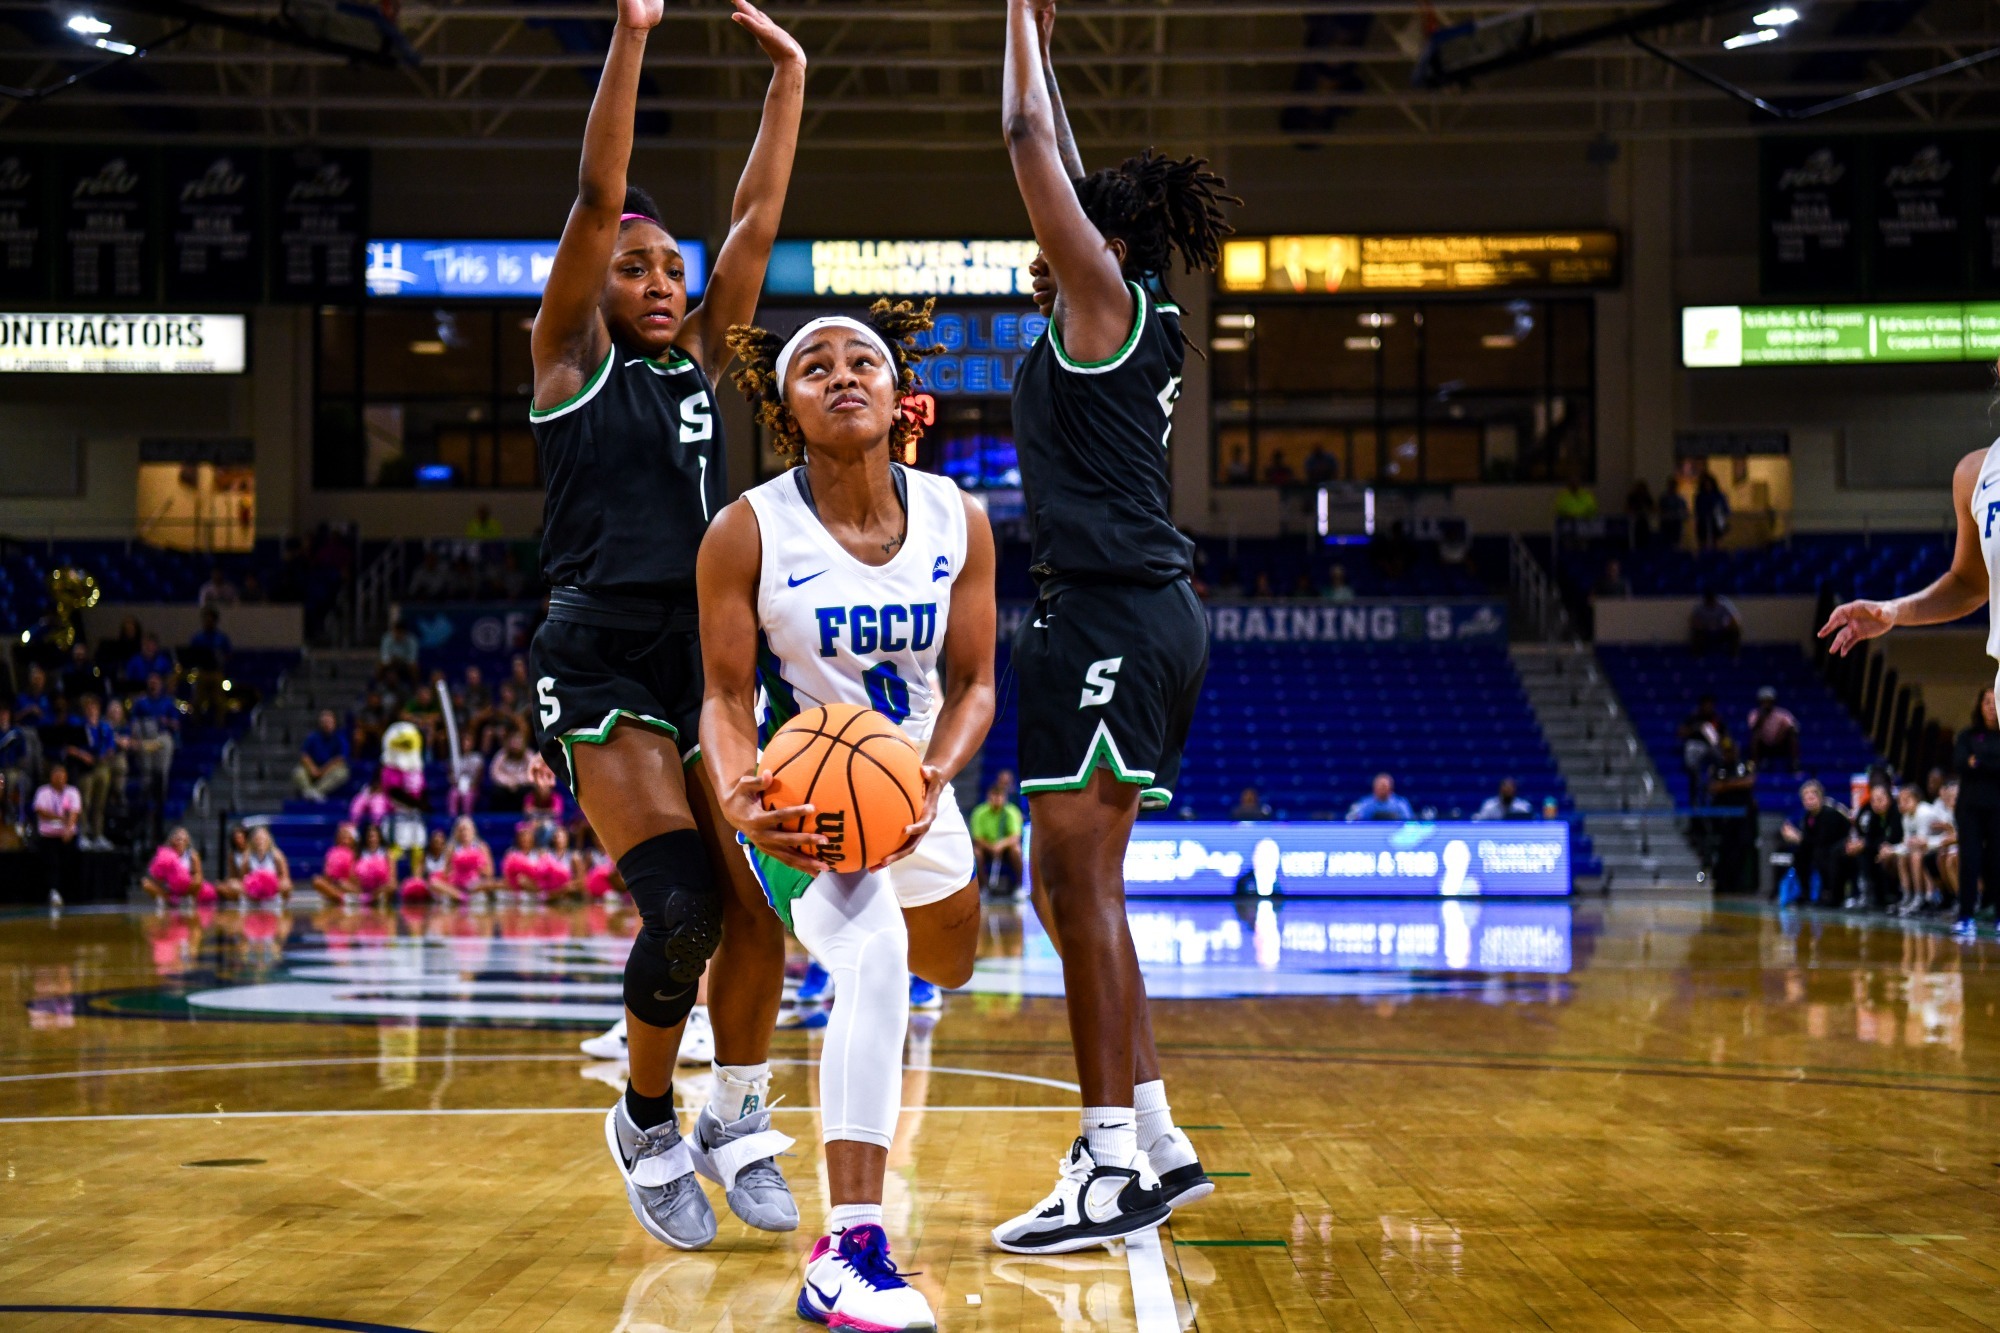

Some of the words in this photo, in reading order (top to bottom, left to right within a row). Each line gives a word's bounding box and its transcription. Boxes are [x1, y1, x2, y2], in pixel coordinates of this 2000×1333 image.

[422, 246, 489, 284] This
[496, 246, 522, 284] is
[814, 266, 1012, 295] FOUNDATION
[679, 390, 713, 443] S
[815, 602, 938, 657] FGCU
[537, 676, 561, 732] S
[862, 660, 911, 725] 0
[1079, 656, 1123, 709] S
